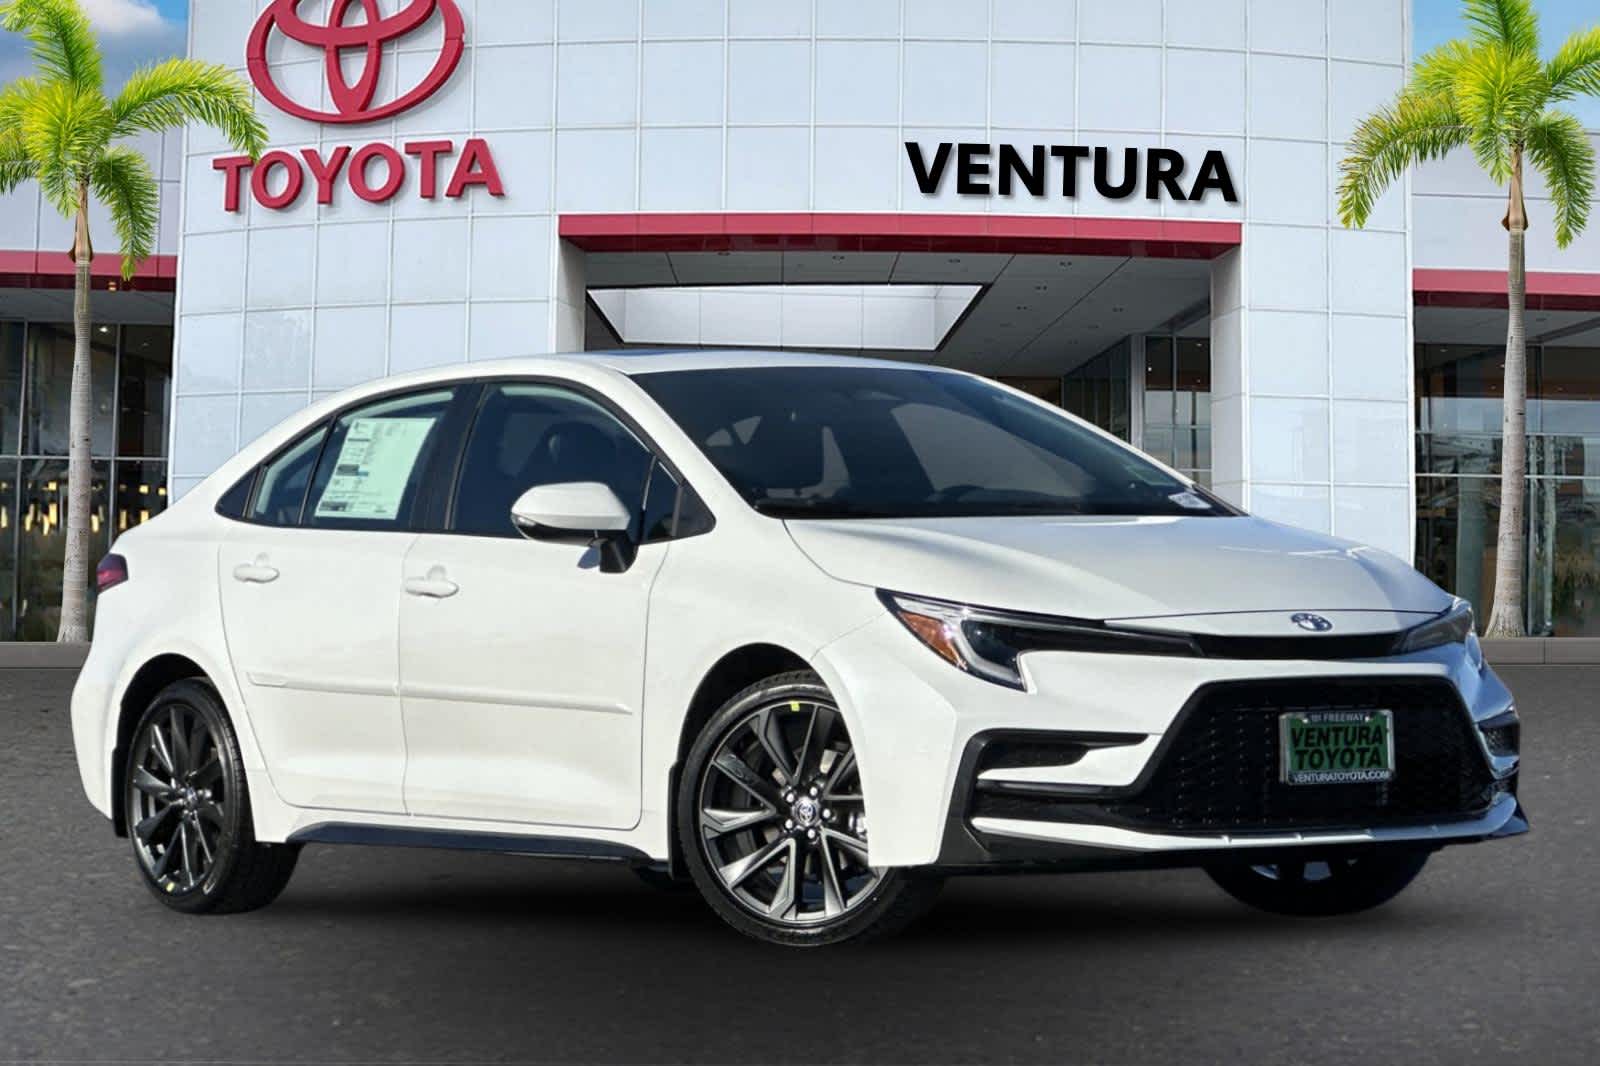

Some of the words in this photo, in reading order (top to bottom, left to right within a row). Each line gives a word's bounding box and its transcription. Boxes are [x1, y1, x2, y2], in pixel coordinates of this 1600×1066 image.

[212, 138, 505, 212] TOYOTA
[904, 141, 1239, 203] VENTURA
[1323, 712, 1365, 722] FREEWAY
[1290, 725, 1383, 748] VENTURA
[1295, 747, 1383, 770] TOYOTA
[1293, 770, 1390, 783] VENTURATOYOTA.COM
